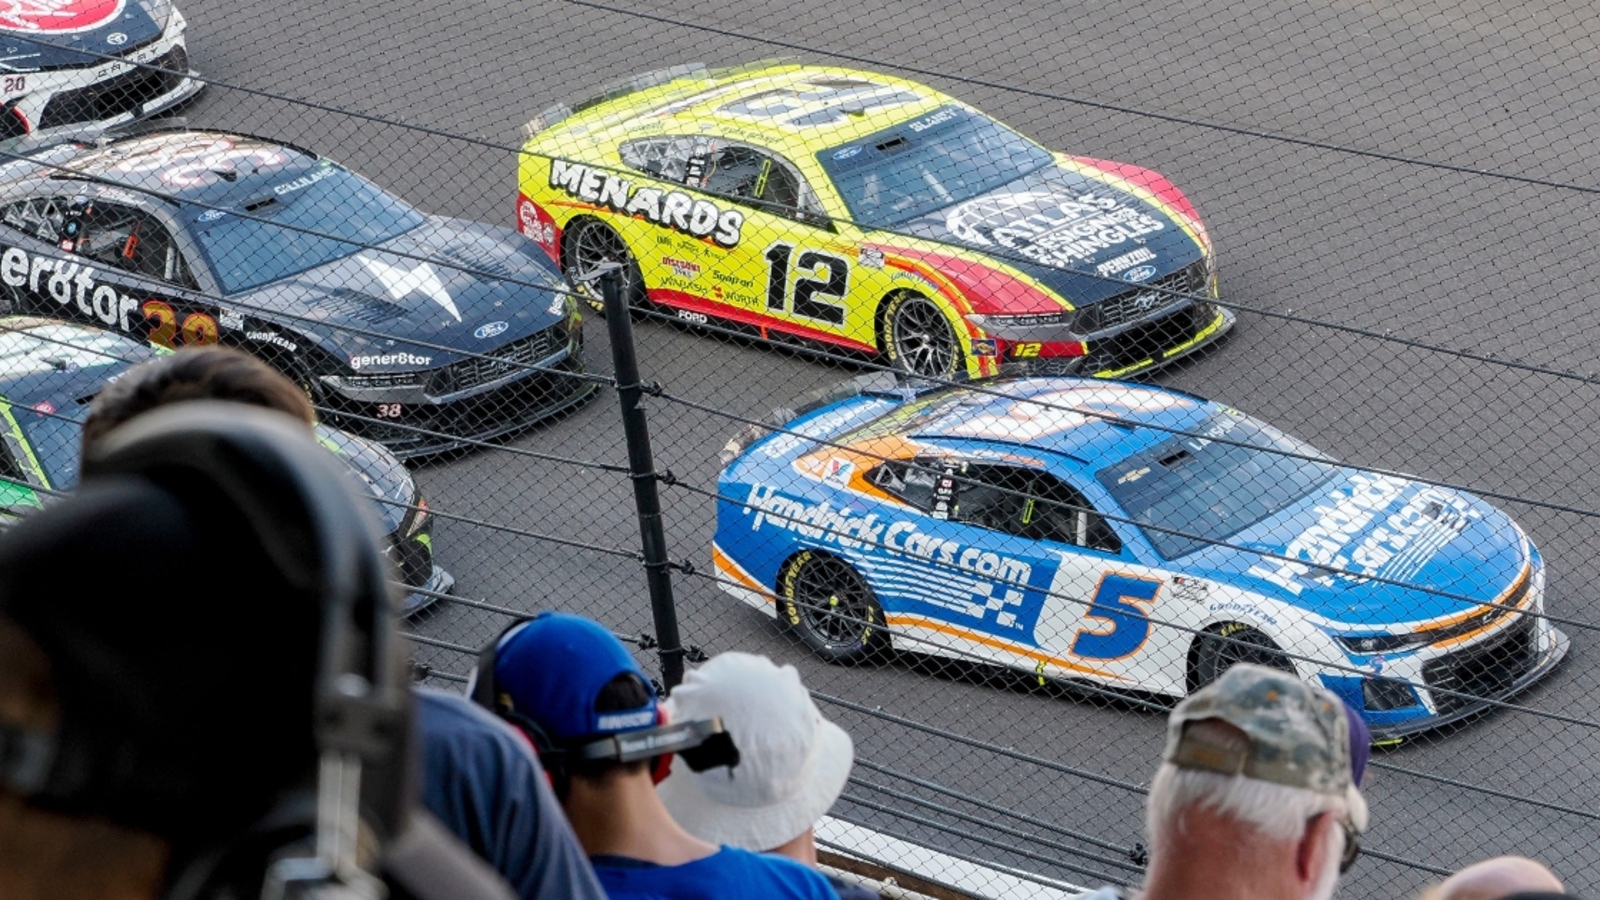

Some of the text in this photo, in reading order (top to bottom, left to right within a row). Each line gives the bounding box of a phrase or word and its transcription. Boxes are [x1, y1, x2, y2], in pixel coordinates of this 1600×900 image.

[5, 77, 25, 92] 20
[550, 159, 742, 247] MENARDS
[1097, 247, 1157, 277] PENNZOIL
[1, 247, 139, 332] er8tor
[764, 240, 850, 328] 12
[678, 309, 708, 323] FORD
[350, 352, 432, 369] gener8tor
[1014, 343, 1042, 357] 12
[376, 403, 401, 418] 38
[1067, 570, 1164, 663] 5
